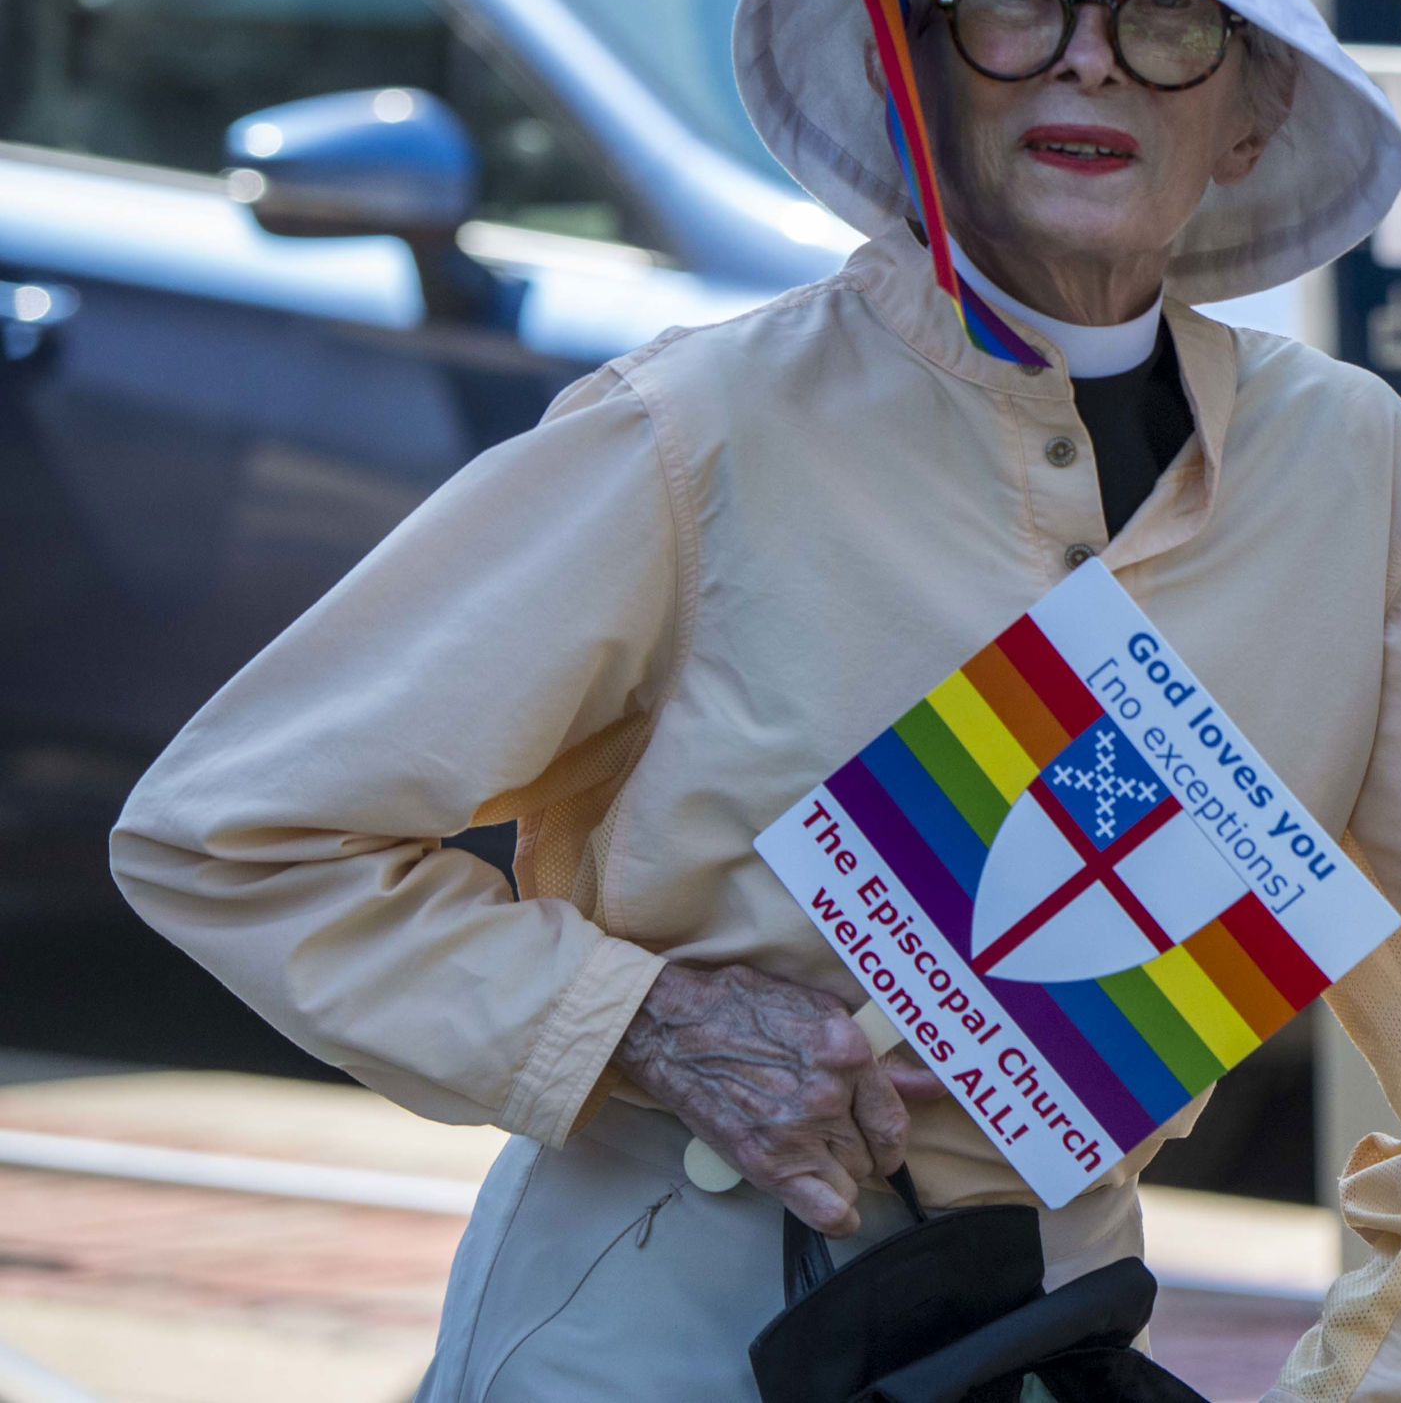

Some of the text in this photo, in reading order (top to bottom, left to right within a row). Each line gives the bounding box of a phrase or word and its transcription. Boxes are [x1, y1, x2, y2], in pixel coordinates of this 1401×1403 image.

[1084, 656, 1306, 915] [no exceptions]
[1125, 630, 1337, 883] God loves you
[803, 800, 1102, 1174] The Episcopal Church
[810, 886, 1030, 1146] welcomes ALL!
